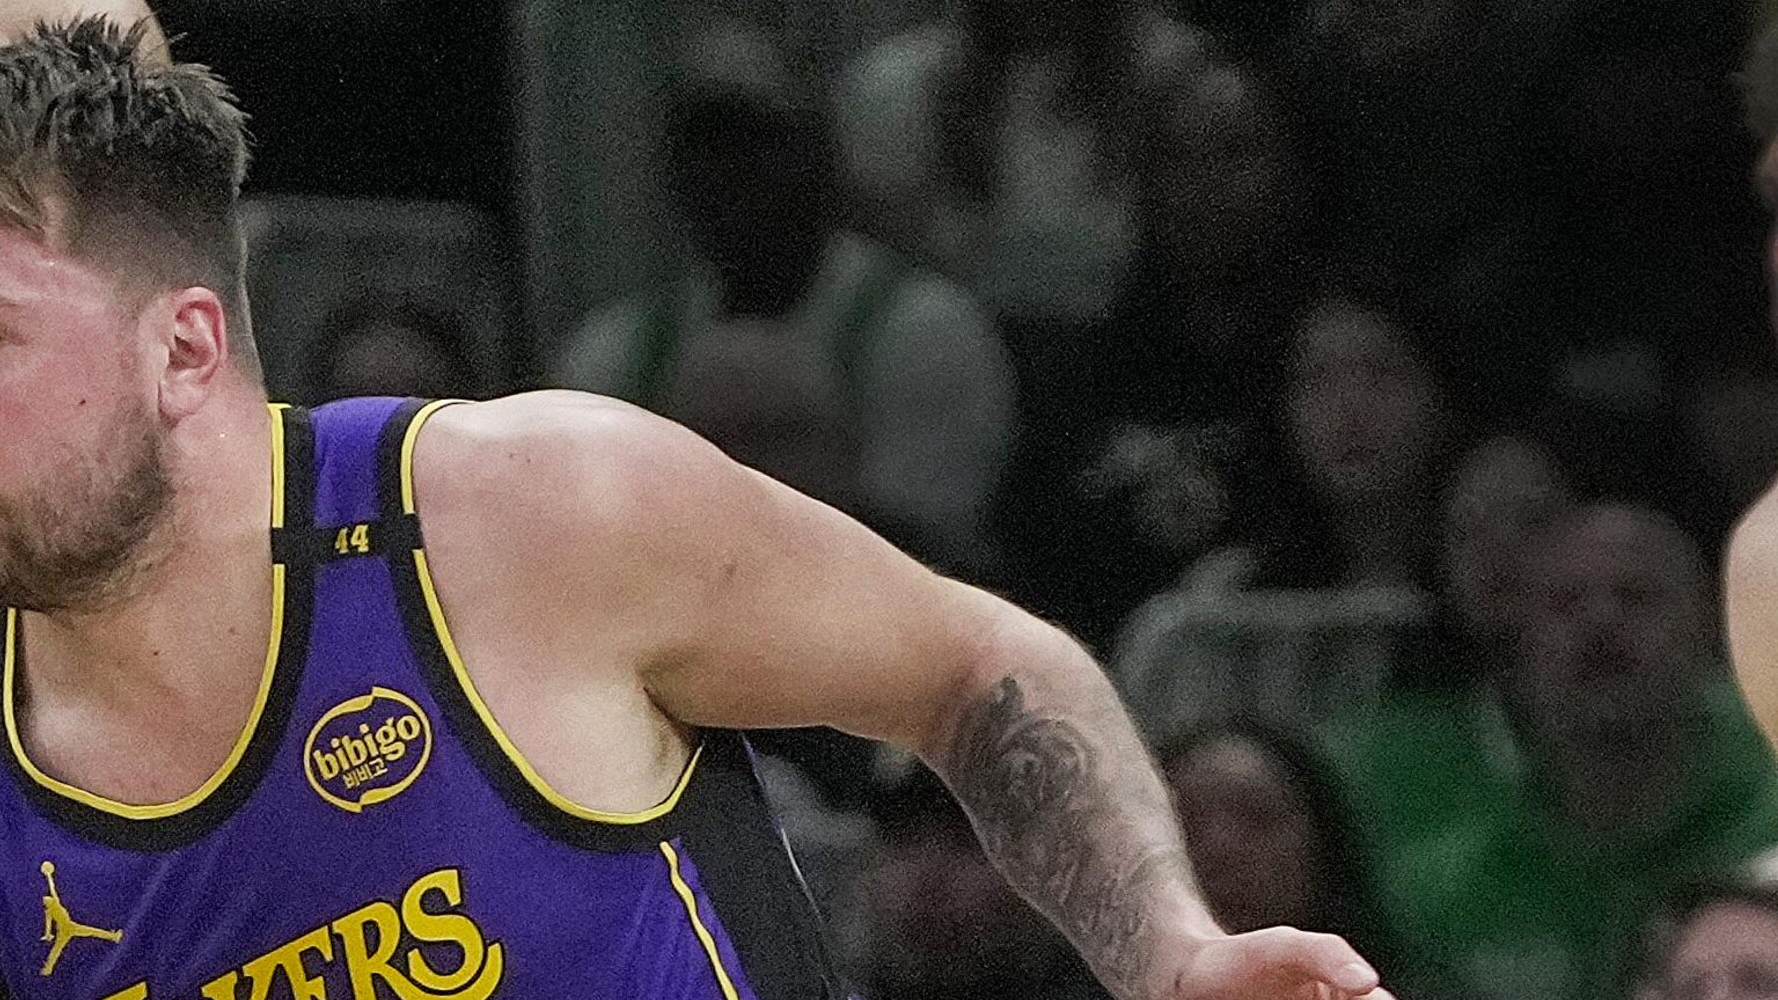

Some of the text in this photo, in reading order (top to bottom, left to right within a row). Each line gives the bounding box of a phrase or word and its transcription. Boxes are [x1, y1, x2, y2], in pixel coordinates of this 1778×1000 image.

[334, 524, 370, 554] 44
[313, 715, 421, 780] bibigo
[343, 758, 389, 789] 비비고
